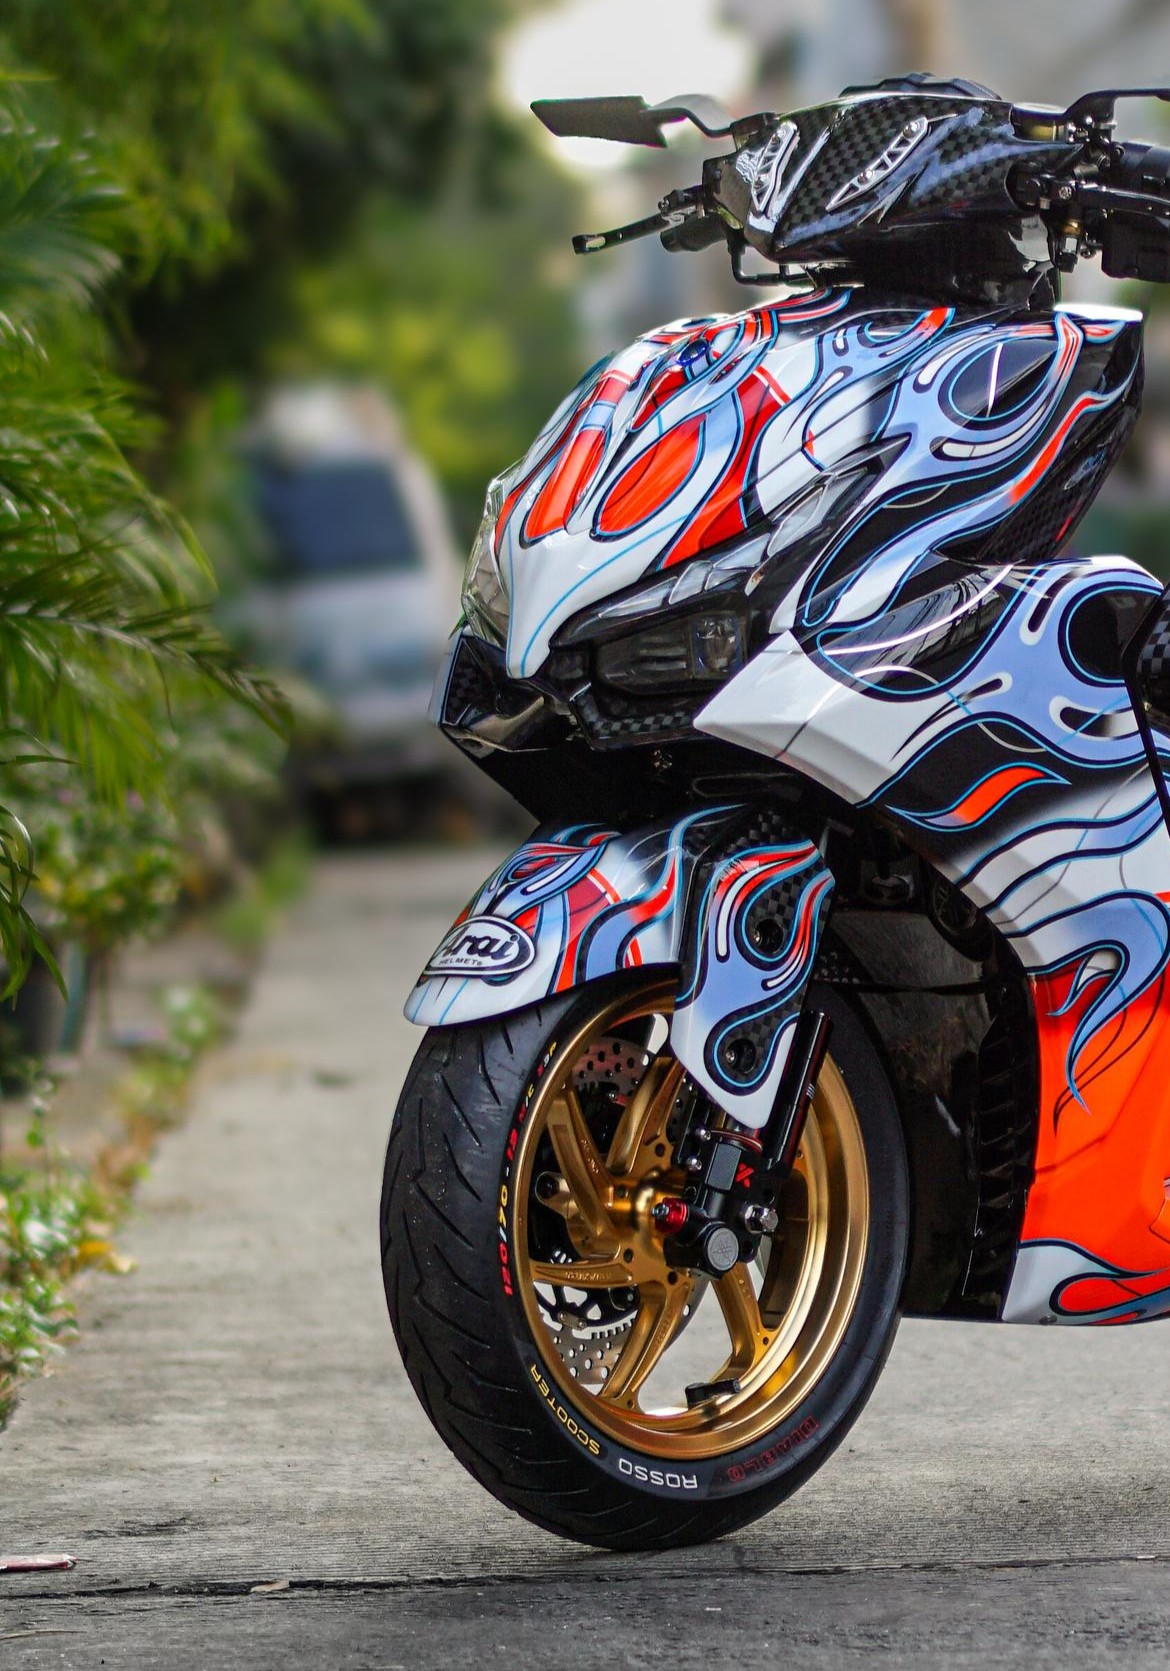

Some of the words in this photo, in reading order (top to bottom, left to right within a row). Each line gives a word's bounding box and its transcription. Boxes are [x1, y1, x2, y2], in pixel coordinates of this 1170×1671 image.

[530, 1364, 601, 1455] SCOOTER
[618, 1457, 698, 1490] ROSSO
[727, 1414, 821, 1482] DIABLO
